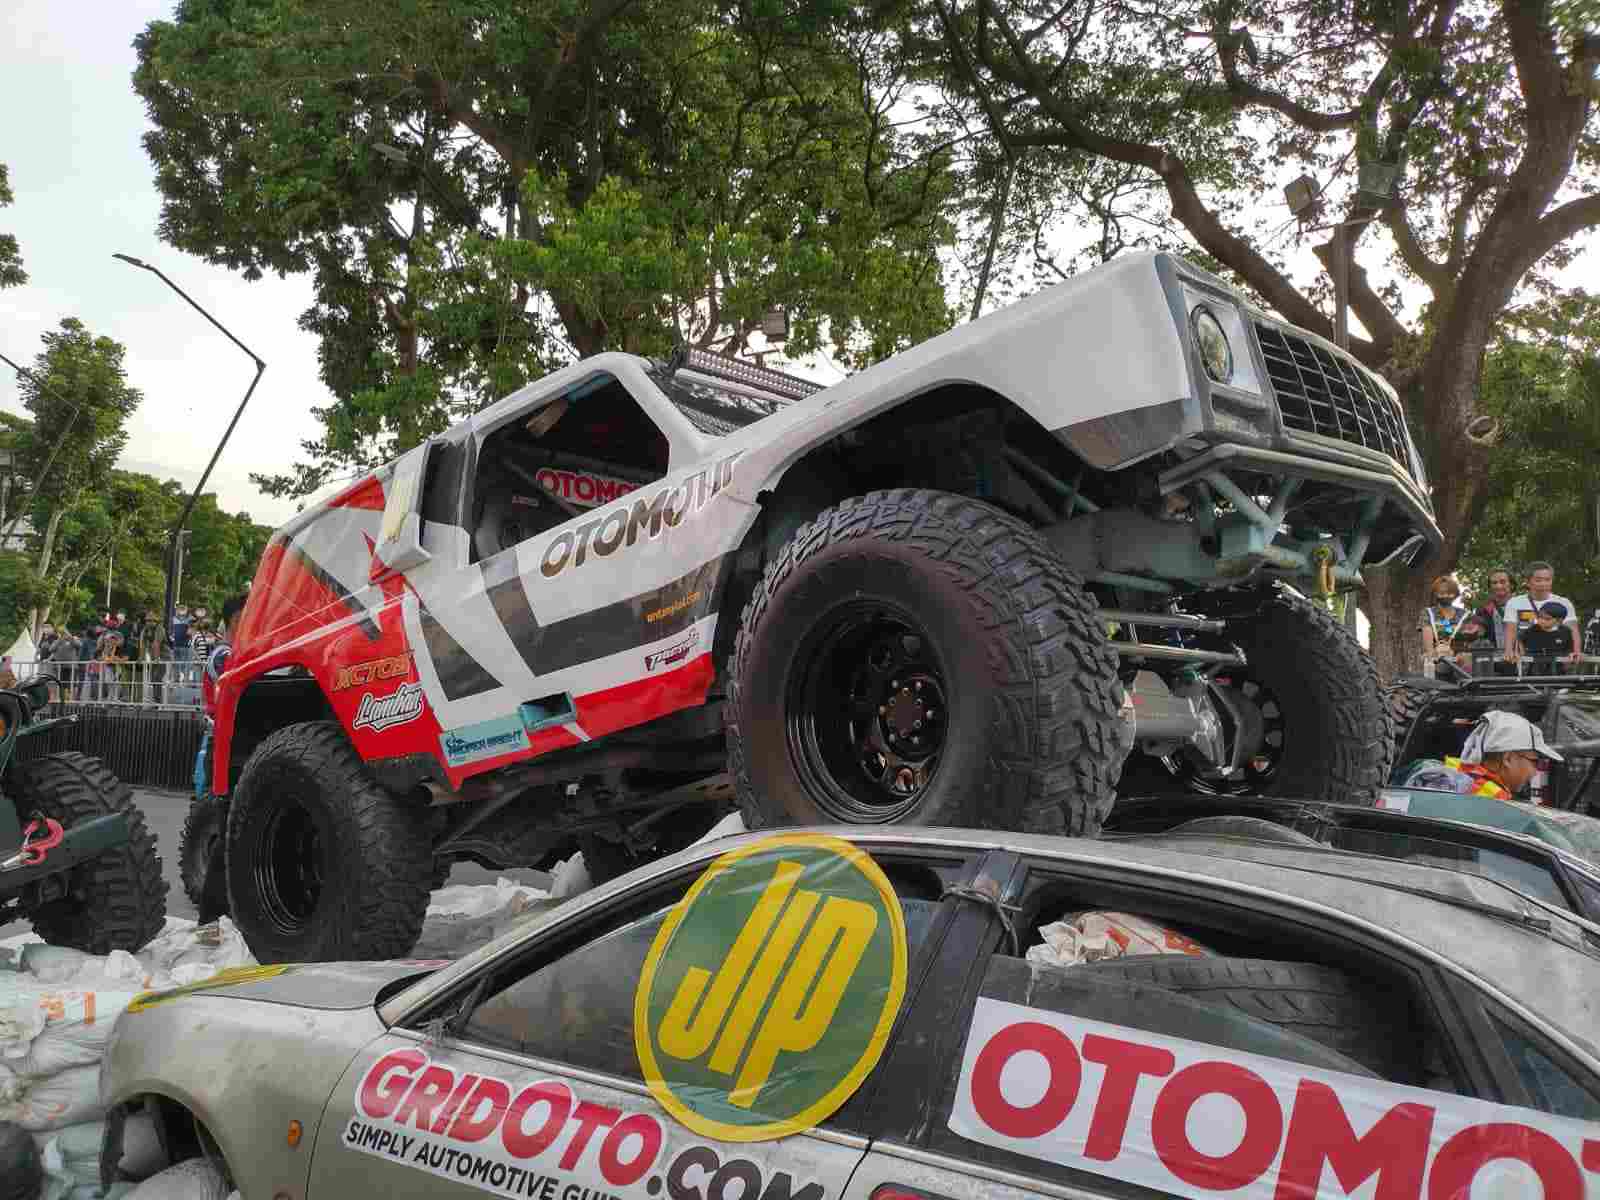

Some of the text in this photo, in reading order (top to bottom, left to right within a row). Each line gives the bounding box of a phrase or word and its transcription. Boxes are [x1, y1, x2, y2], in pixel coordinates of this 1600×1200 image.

[346, 1121, 415, 1159] SIMPLY
[413, 1141, 560, 1200] AUTOMOTIVE
[971, 1021, 1600, 1200] OTOMO
